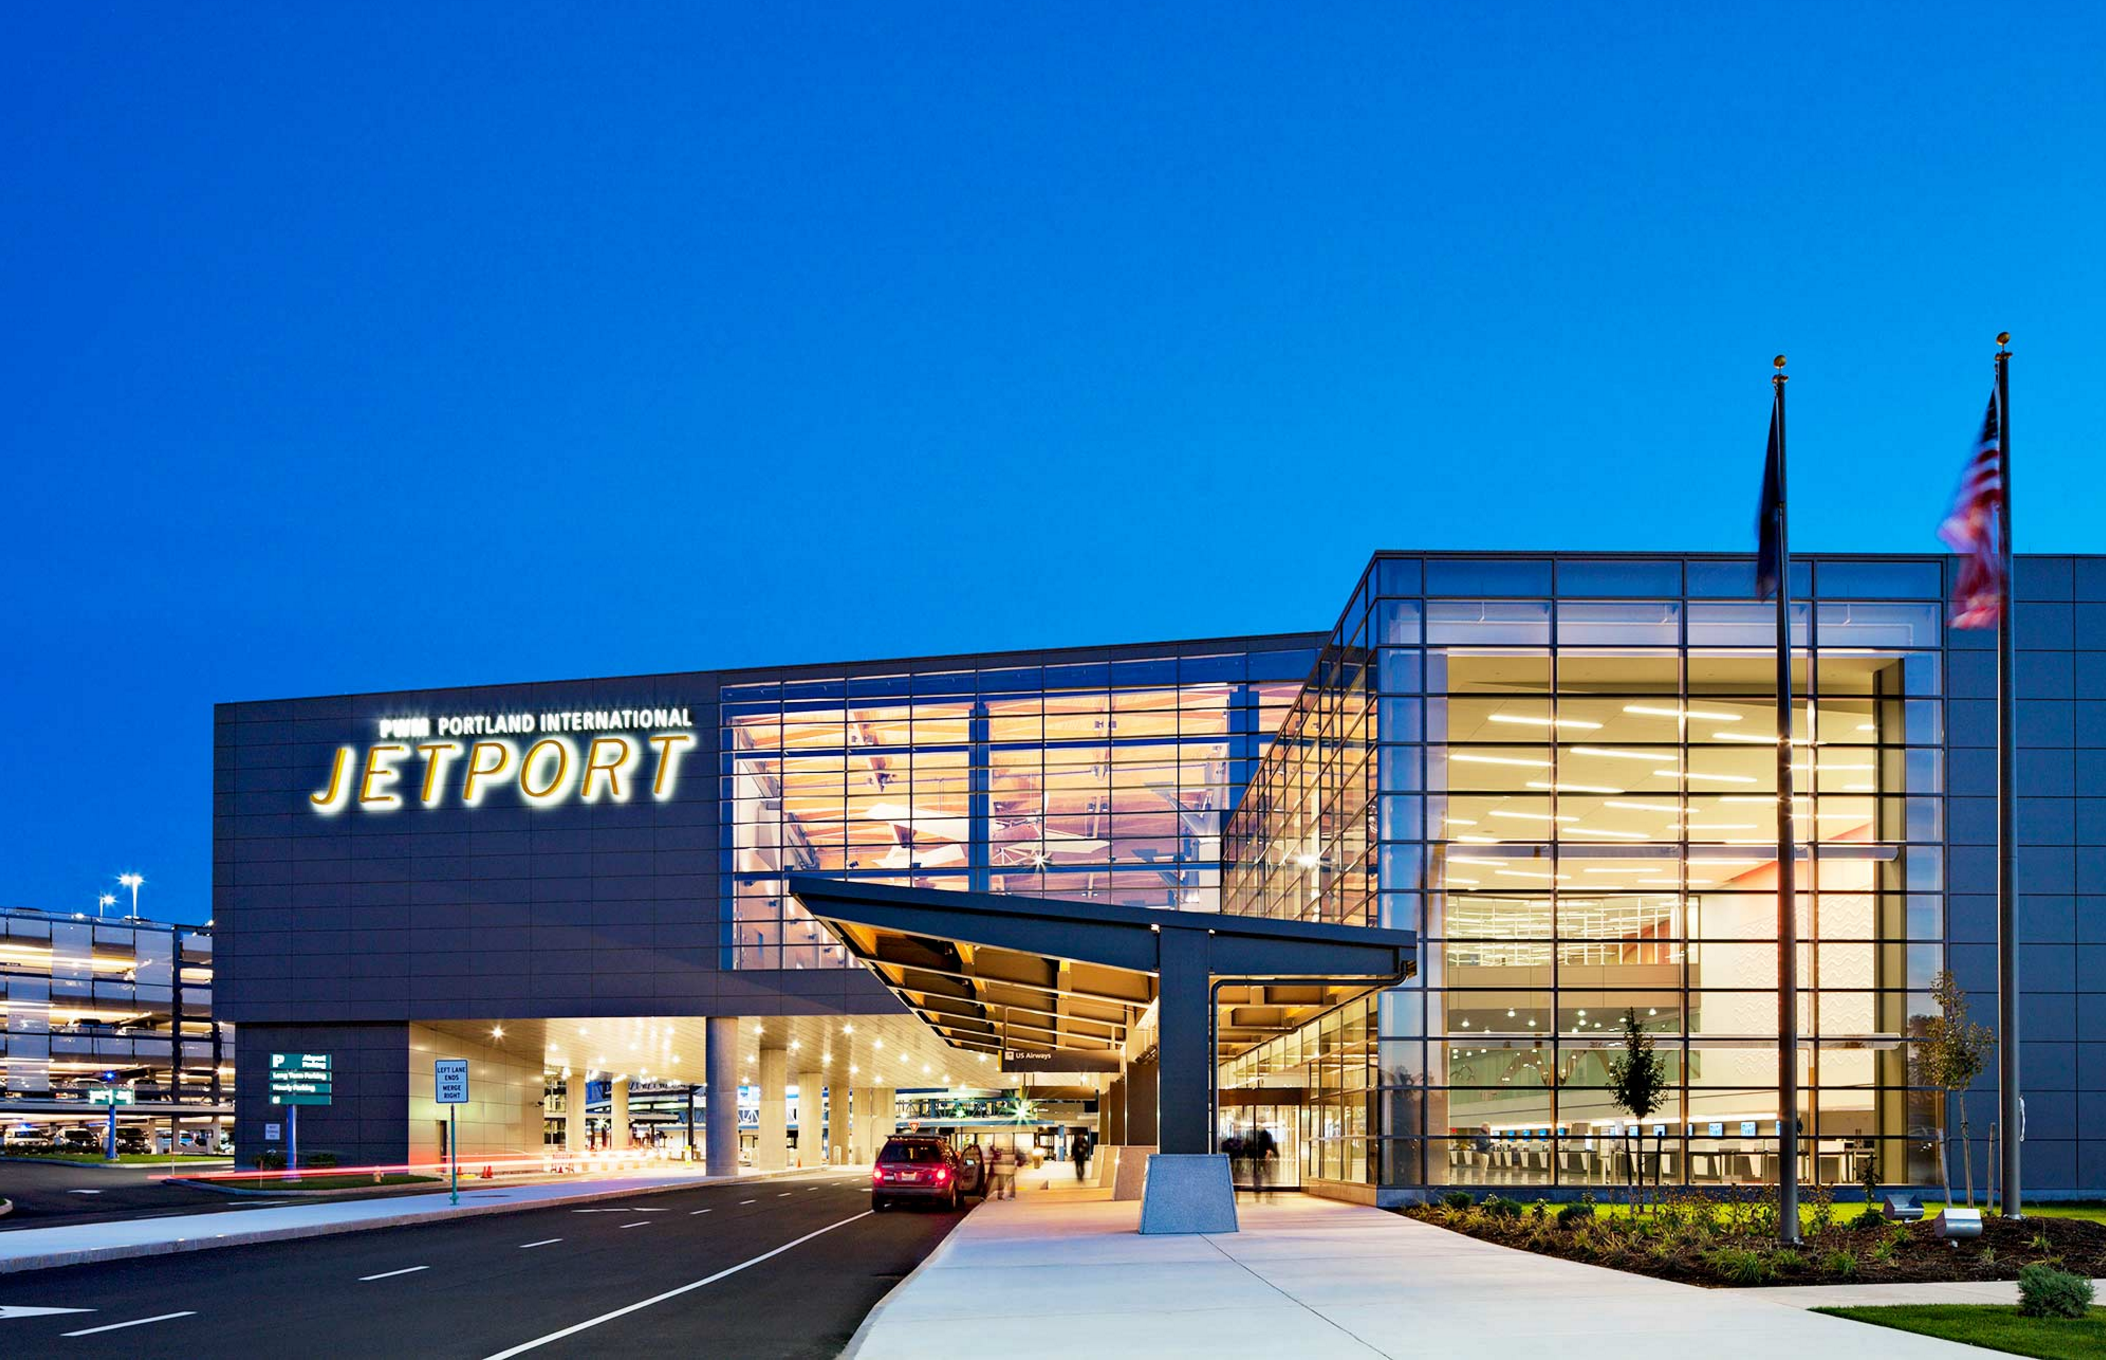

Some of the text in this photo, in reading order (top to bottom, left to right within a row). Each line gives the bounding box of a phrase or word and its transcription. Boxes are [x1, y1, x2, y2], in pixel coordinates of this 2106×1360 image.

[380, 707, 692, 738] PWM PORTLAND INTERNATIONAL
[309, 734, 692, 806] JETPORT
[272, 1054, 285, 1068] P
[1026, 1052, 1051, 1060] Airways
[273, 1072, 288, 1080] Long
[304, 1072, 327, 1081] Parking
[292, 1084, 315, 1093] Parking
